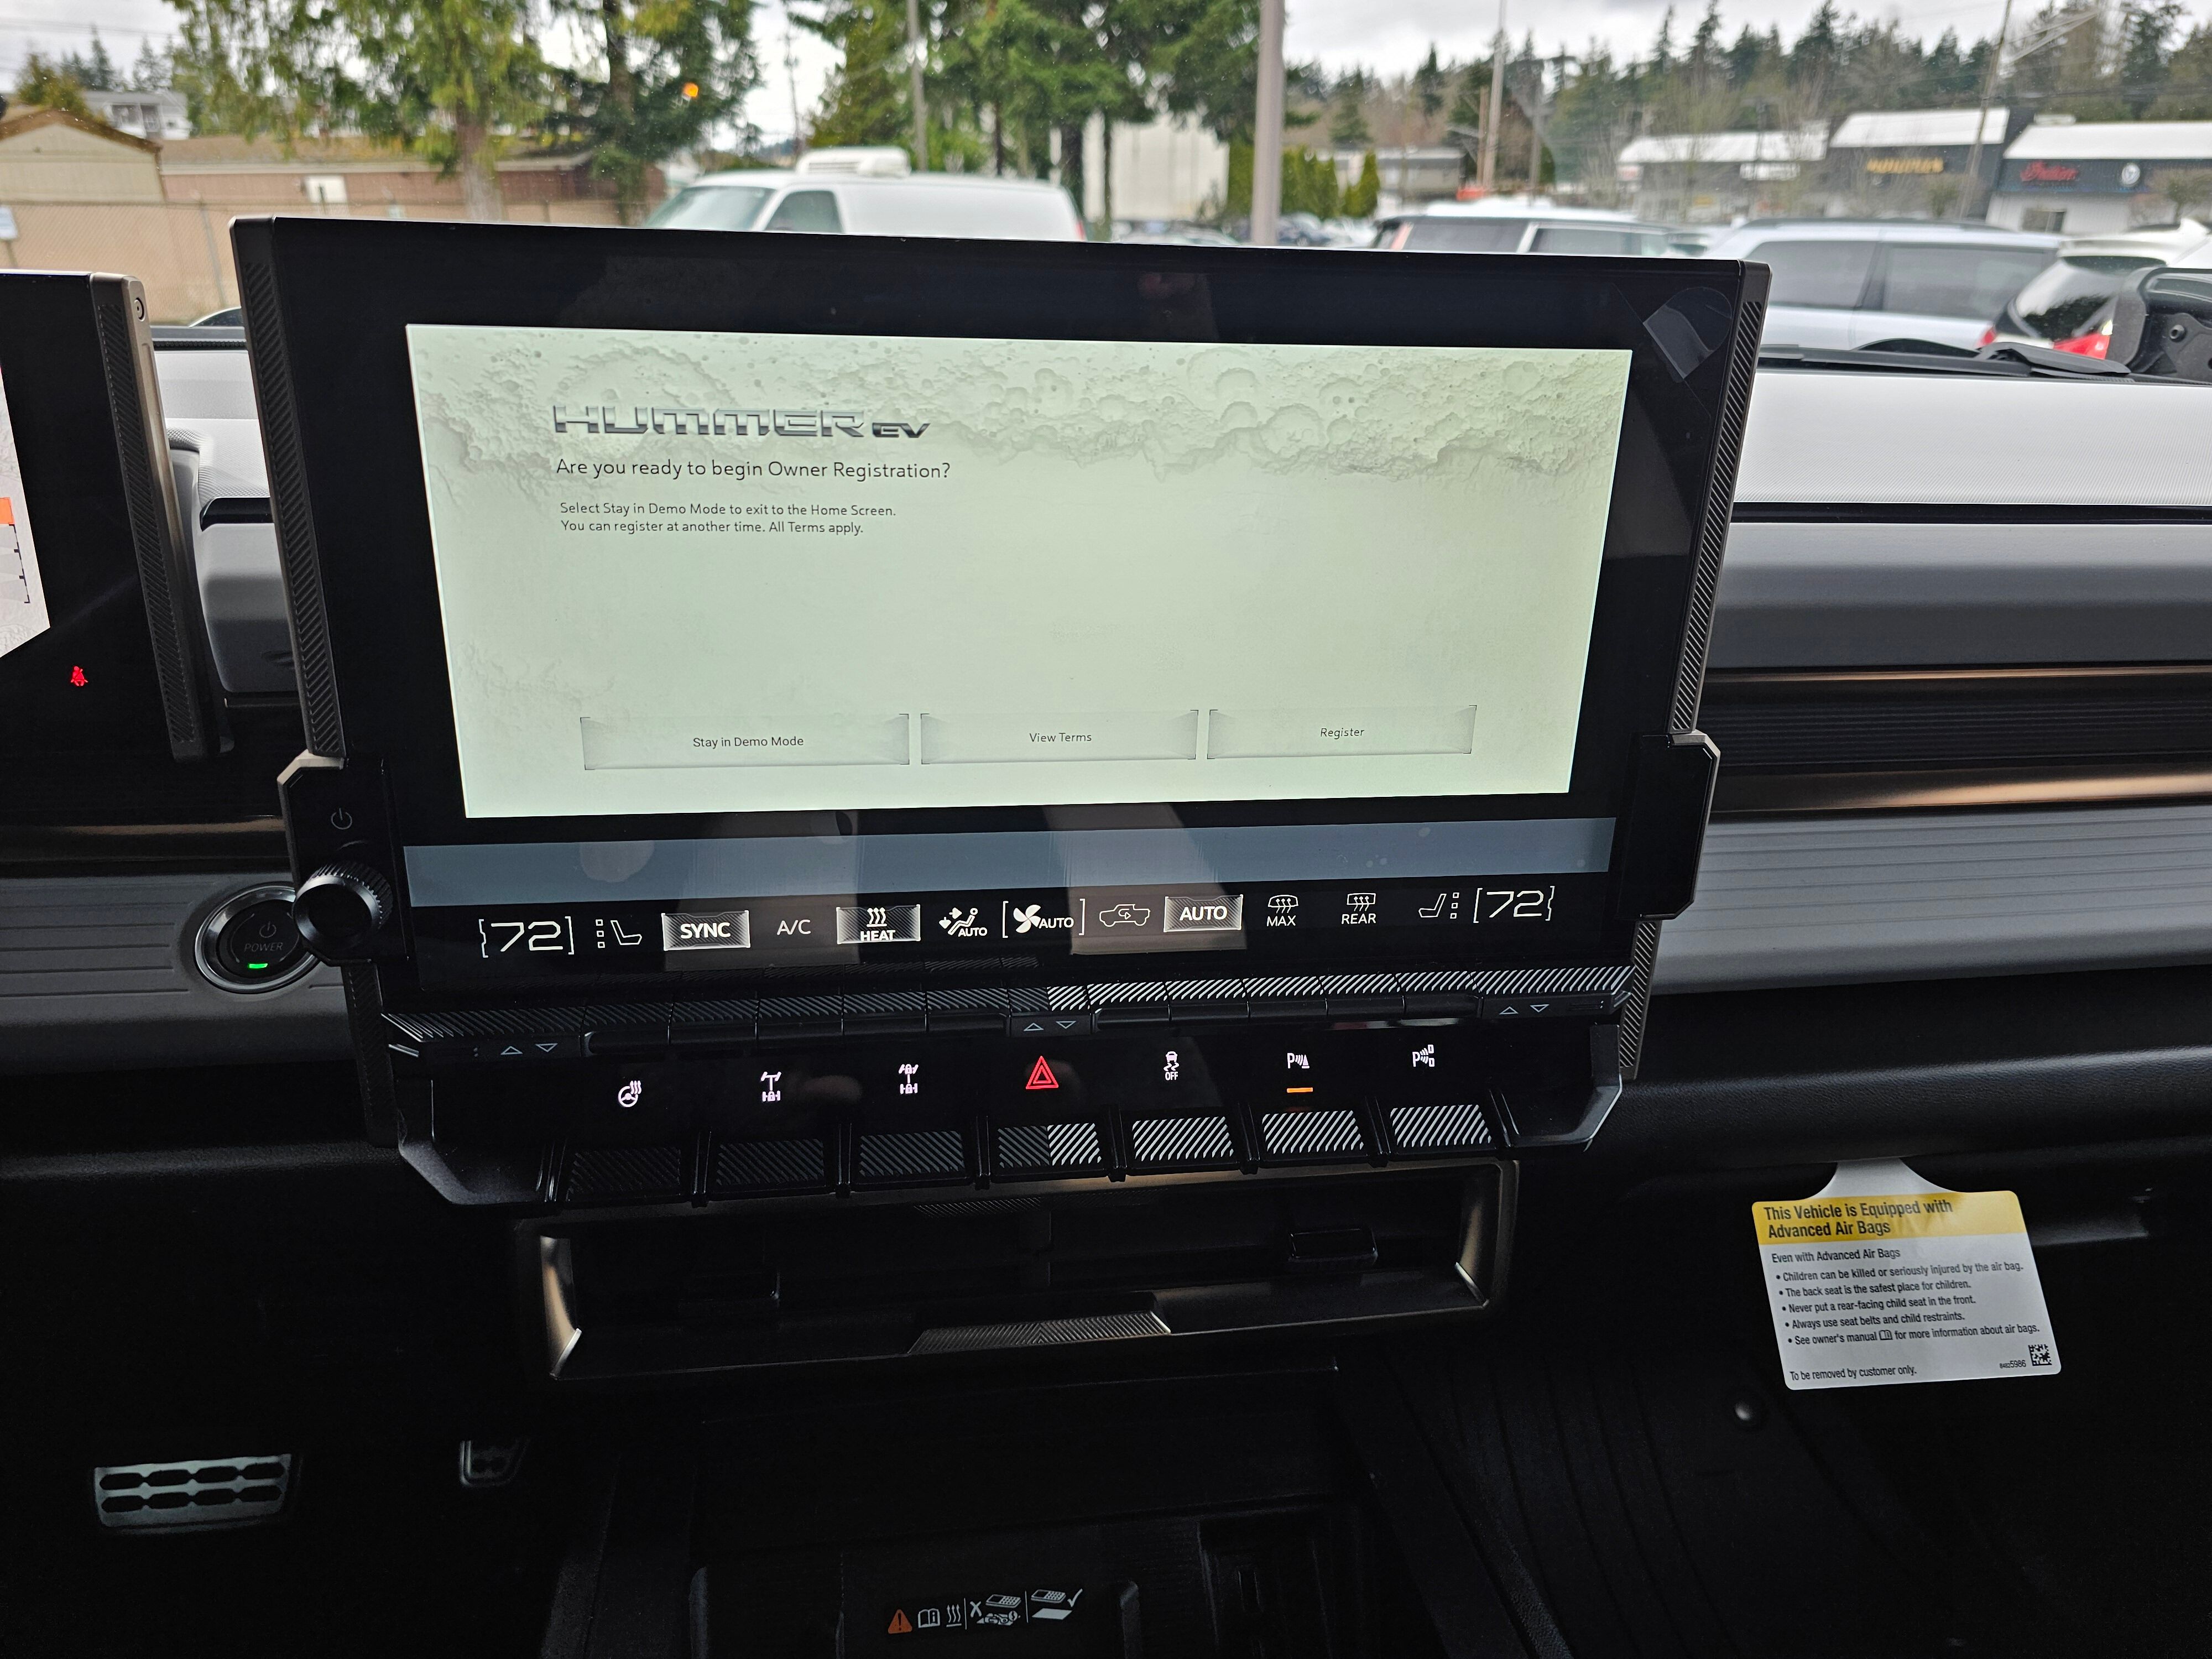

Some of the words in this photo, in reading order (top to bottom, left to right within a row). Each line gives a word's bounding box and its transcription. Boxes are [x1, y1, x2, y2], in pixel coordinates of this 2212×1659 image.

[556, 458, 587, 473] Are
[593, 464, 625, 479] you
[632, 459, 681, 479] ready
[687, 461, 706, 474] to
[712, 460, 762, 480] begin
[769, 461, 827, 476] Owner
[834, 462, 950, 482] Registration?
[561, 502, 599, 513] Select
[603, 503, 629, 517] Stay
[634, 503, 644, 513] in
[649, 503, 686, 514] Demo
[691, 503, 726, 514] Mode
[729, 504, 742, 514] to
[746, 504, 768, 514] exit
[771, 505, 783, 514] to
[787, 504, 806, 514] the
[811, 505, 847, 515] Home
[851, 505, 895, 515] Screen.
[561, 520, 584, 530] You
[614, 520, 663, 534] register
[667, 522, 679, 531] at
[682, 520, 730, 531] another
[734, 521, 765, 531] time.
[769, 521, 784, 531] All
[787, 521, 825, 532] Terms
[828, 522, 863, 536] apply.
[1029, 733, 1056, 742] View
[1058, 733, 1091, 742] Terms
[1321, 728, 1364, 739] Register
[693, 738, 718, 749] Stay
[721, 737, 731, 746] in
[734, 737, 768, 746] Demo
[771, 736, 803, 745] Mode
[1486, 891, 1542, 918] 72
[1180, 906, 1227, 922] AUTO
[1266, 915, 1297, 927] MAX
[1342, 914, 1376, 925] REAR
[680, 922, 731, 940] SYNC
[777, 920, 811, 936] A/C
[1039, 917, 1074, 929] AUTO
[491, 921, 563, 952] 72
[860, 930, 896, 942] HEAT
[958, 927, 988, 937] AUTO
[244, 942, 283, 952] POWER
[1165, 1072, 1178, 1081] OFF
[1763, 1206, 1791, 1220] This
[1795, 1204, 1843, 1218] Vehicle
[1845, 1203, 1857, 1216] is
[1859, 1201, 1921, 1218] Equipped
[1923, 1199, 1952, 1213] with
[1768, 1222, 1831, 1238] Advanced
[1835, 1221, 1853, 1235] Air
[1856, 1220, 1890, 1236] Bags
[1771, 1253, 1793, 1262] Even
[1794, 1252, 1814, 1261] with
[1817, 1249, 1860, 1261] Advanced
[1863, 1249, 1875, 1259] Air
[1877, 1248, 1900, 1259] Bags
[1783, 1271, 1818, 1281] Children
[1838, 1270, 1849, 1279] be
[1851, 1268, 1876, 1277] killed
[1890, 1266, 1928, 1276] seriously
[1930, 1264, 1960, 1275] injured
[1962, 1264, 1972, 1274] by
[1975, 1263, 1989, 1271] the
[1991, 1262, 2002, 1271] air
[2004, 1262, 2023, 1271] bag.
[1785, 1288, 1801, 1297] The
[1802, 1286, 1823, 1296] back
[1824, 1286, 1843, 1295] seat
[1843, 1285, 1852, 1294] is
[1853, 1285, 1867, 1293] the
[1869, 1283, 1896, 1293] safest
[1897, 1282, 1919, 1293] place
[1921, 1281, 1933, 1290] for
[1936, 1280, 1971, 1289] children.
[1788, 1304, 1812, 1312] Never
[1814, 1302, 1829, 1313] put
[1837, 1300, 1884, 1310] rear-facing
[1886, 1298, 1907, 1308] child
[1908, 1297, 1927, 1306] seat
[1928, 1297, 1936, 1305] in
[1938, 1296, 1952, 1305] the
[1953, 1295, 1975, 1304] front.
[1792, 1319, 1821, 1329] Always
[1840, 1317, 1859, 1326] seat
[1859, 1316, 1881, 1325] belts
[1882, 1314, 1898, 1323] and
[1901, 1313, 1921, 1323] child
[1923, 1312, 1965, 1322] restraints.
[1794, 1335, 1810, 1345] See
[1812, 1334, 1845, 1344] owner's
[1846, 1332, 1877, 1342] manual
[1894, 1331, 1906, 1339] for
[1908, 1331, 1930, 1339] more
[1931, 1327, 1978, 1337] information
[1980, 1325, 2004, 1334] about
[2005, 1324, 2015, 1333] air
[2016, 1324, 2039, 1334] bags.
[1790, 1371, 1799, 1380] To
[1800, 1371, 1810, 1380] be
[1812, 1368, 1846, 1379] removed
[1846, 1368, 1856, 1379] by
[1859, 1367, 1896, 1376] customer
[1898, 1365, 1917, 1376] only.
